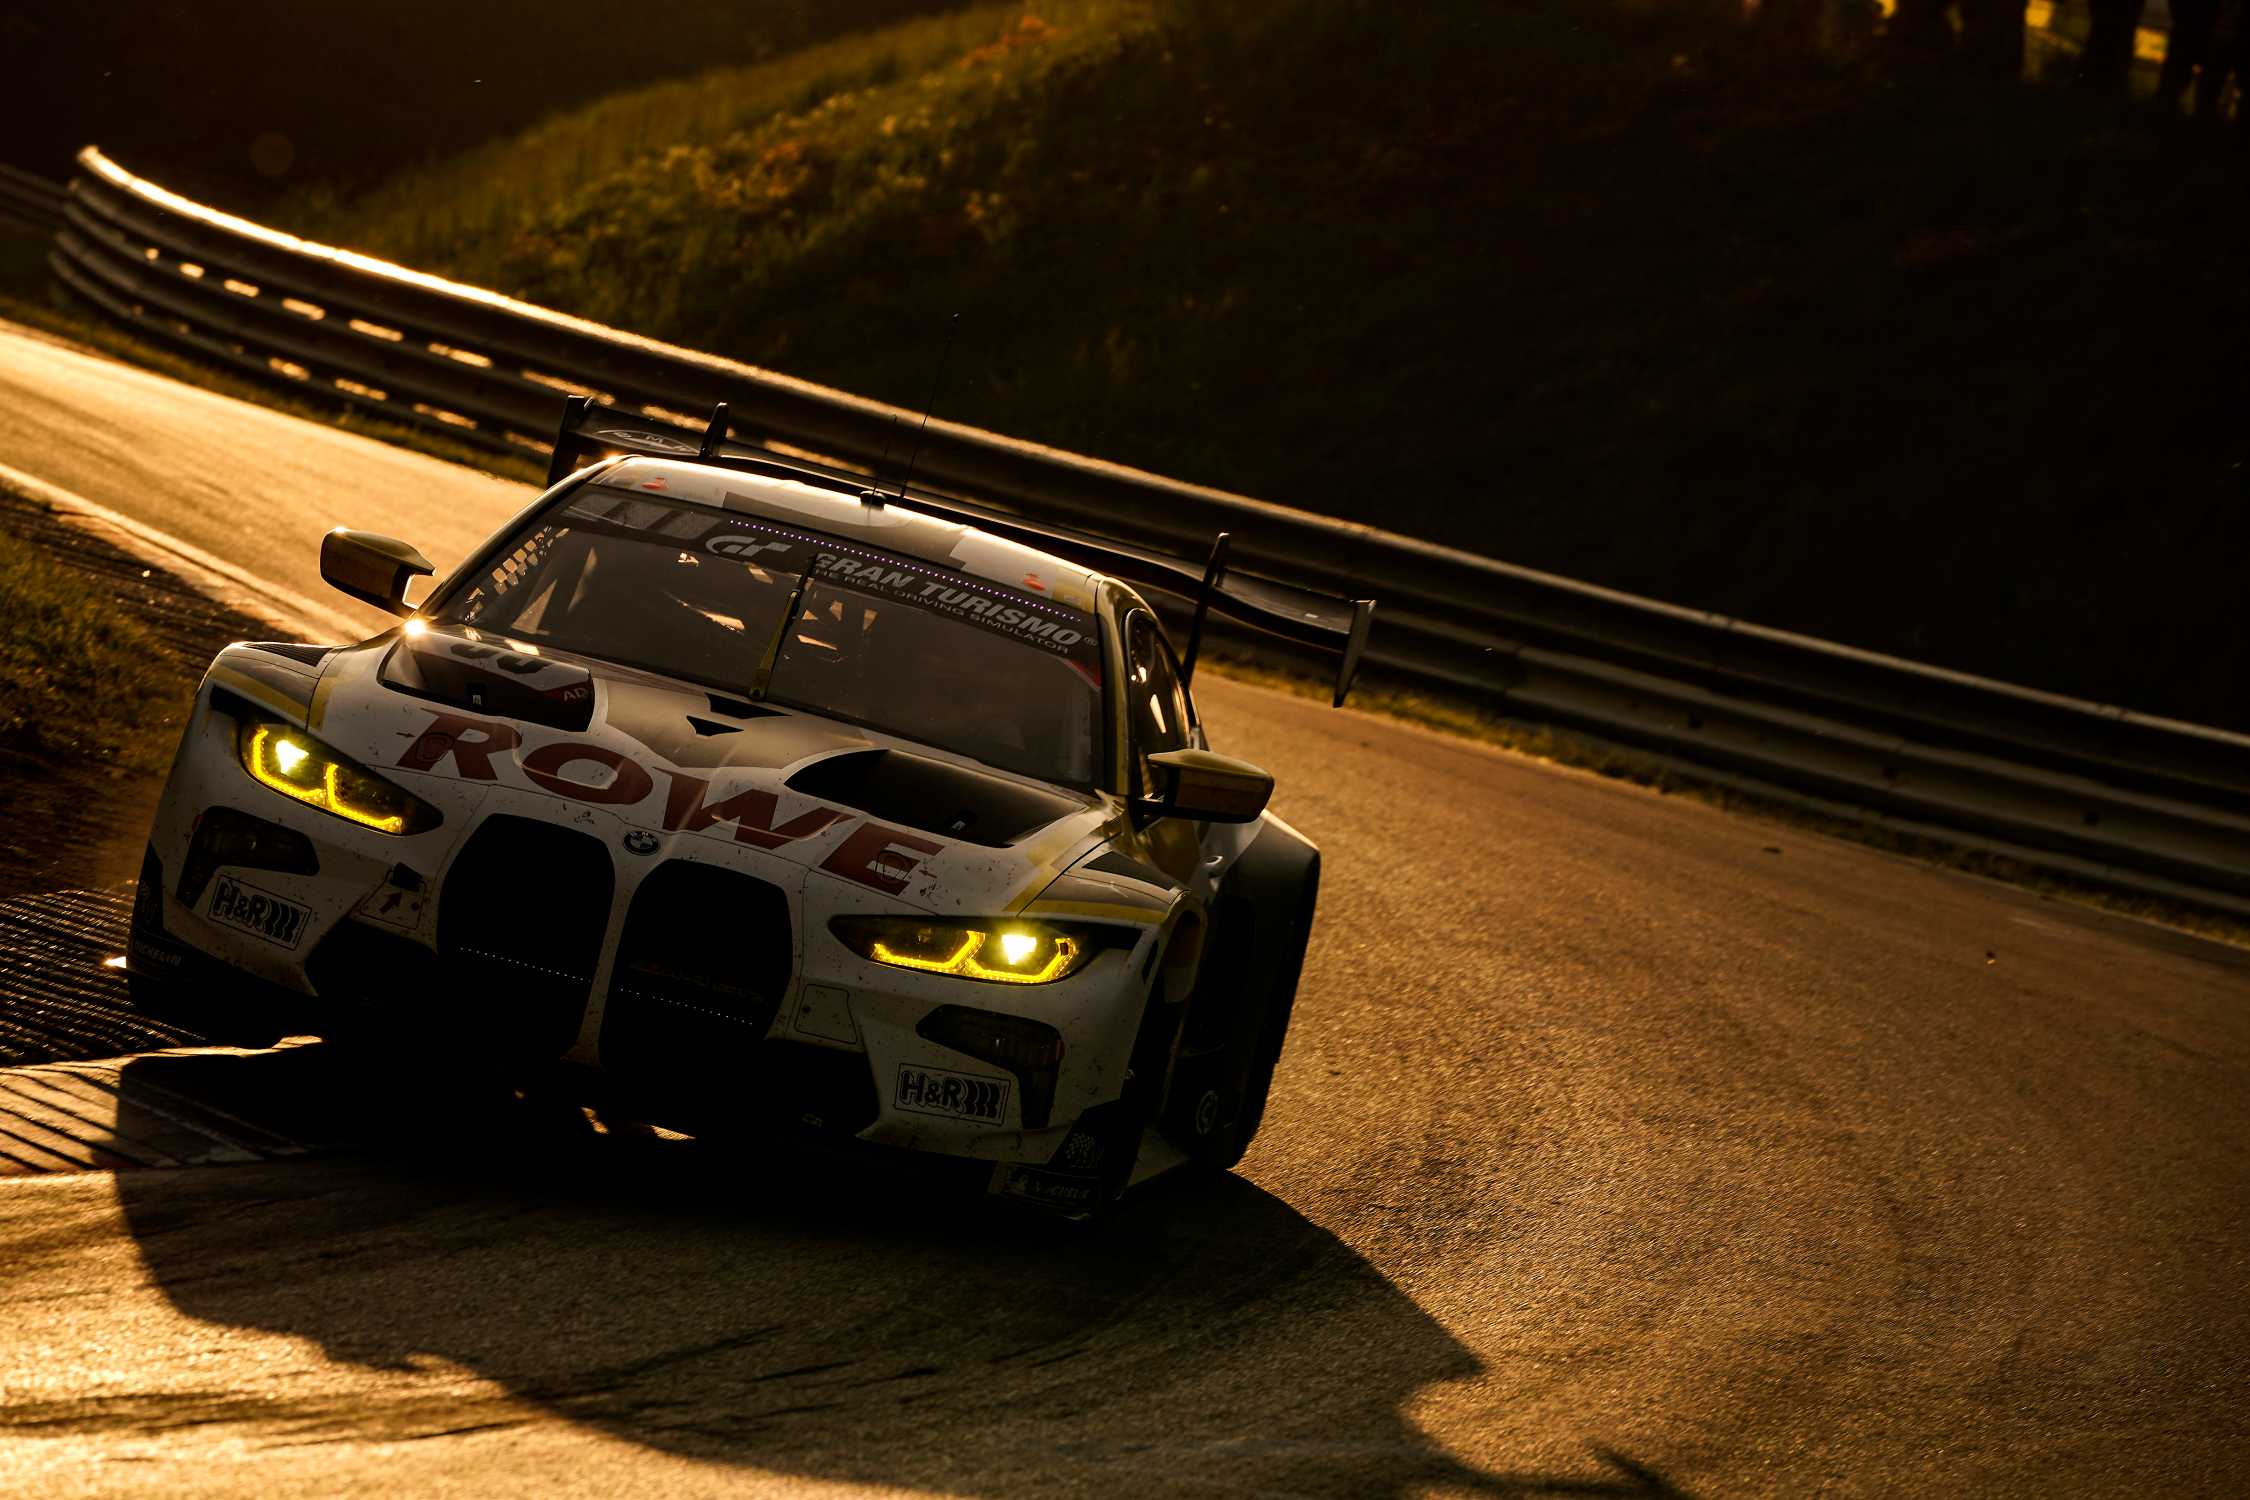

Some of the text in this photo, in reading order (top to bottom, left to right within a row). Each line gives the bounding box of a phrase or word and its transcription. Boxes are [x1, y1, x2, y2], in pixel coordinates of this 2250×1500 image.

[815, 553, 1082, 646] GRAN TURISMO
[893, 589, 965, 617] DRIVING
[968, 612, 1070, 655] SIMULATOR
[396, 707, 946, 896] ROWE
[212, 881, 269, 931] H&R
[901, 1070, 964, 1110] H&R
